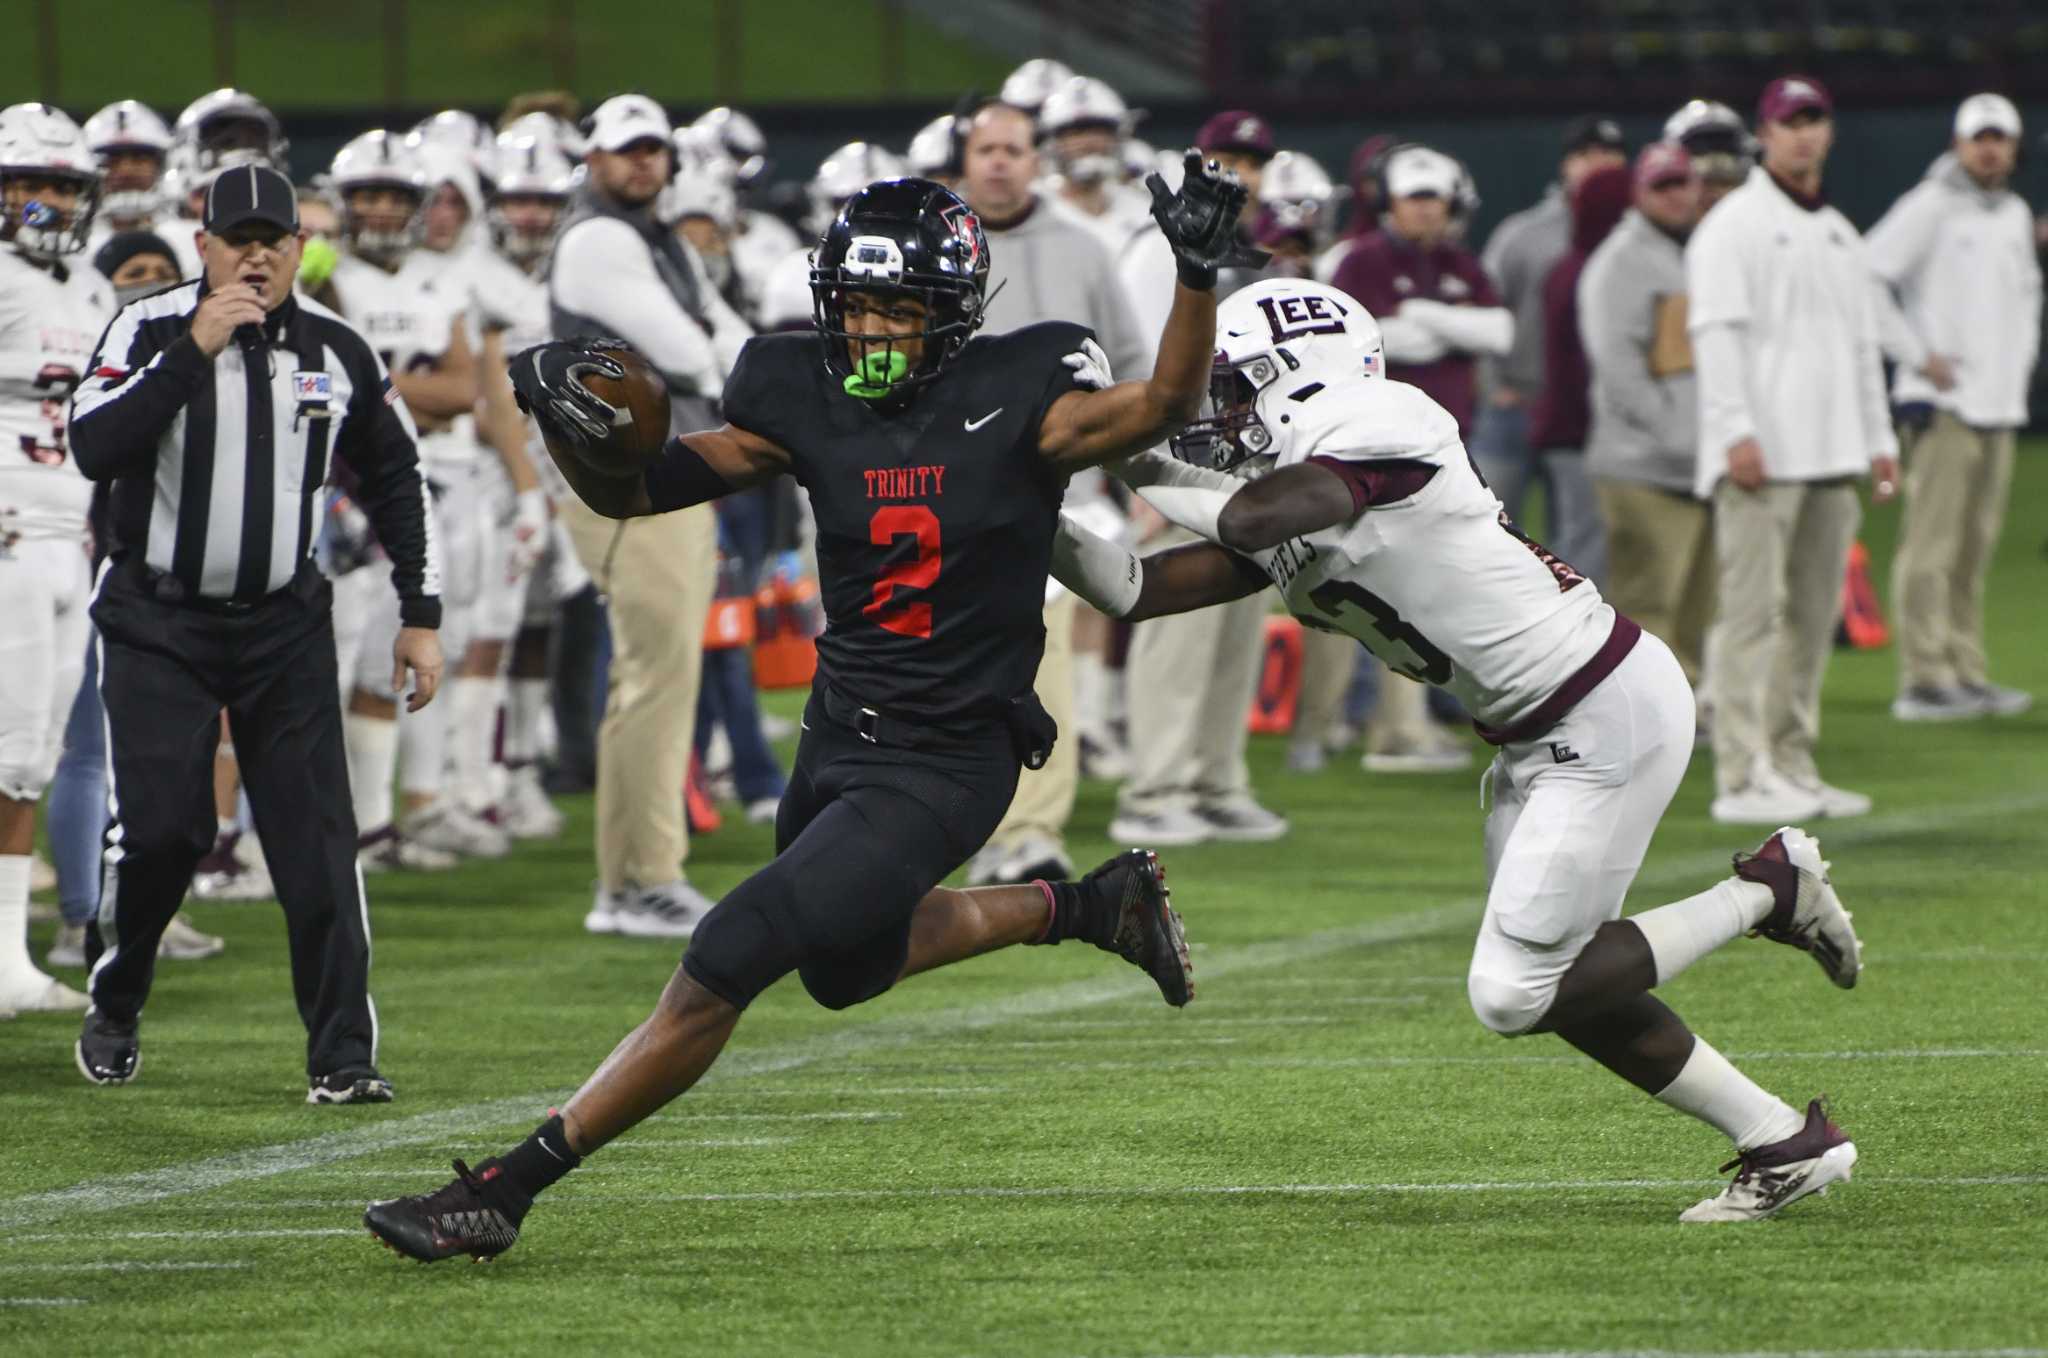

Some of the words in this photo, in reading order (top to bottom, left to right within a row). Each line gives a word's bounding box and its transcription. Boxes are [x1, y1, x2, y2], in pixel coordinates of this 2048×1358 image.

[1256, 296, 1347, 345] LEE
[863, 466, 945, 498] TRINITY
[863, 505, 942, 639] 2
